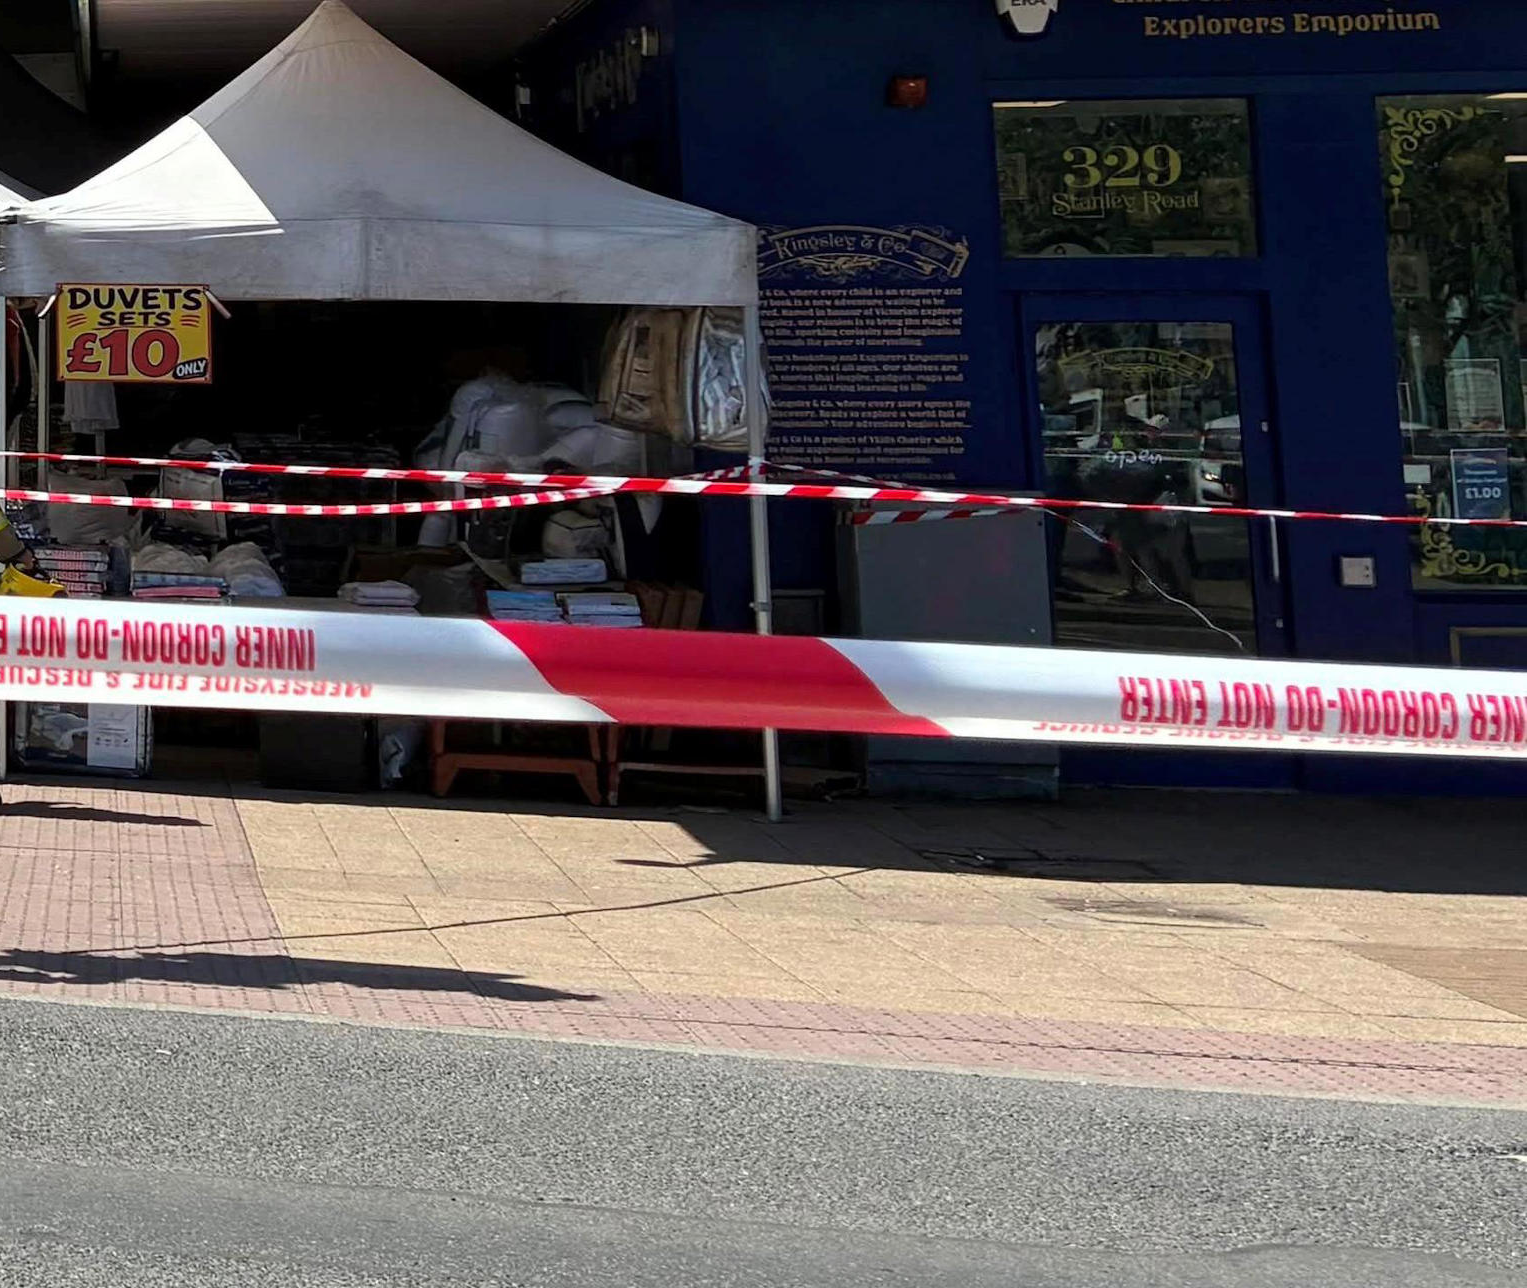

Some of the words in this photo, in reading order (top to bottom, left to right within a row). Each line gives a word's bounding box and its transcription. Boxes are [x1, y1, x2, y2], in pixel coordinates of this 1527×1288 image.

[1144, 14, 1285, 39] Explorers
[1294, 10, 1440, 36] Emporium
[1063, 144, 1182, 188] 329
[1052, 192, 1137, 216] Stanley
[1143, 190, 1199, 214] Road
[775, 233, 857, 261] Kingsley
[67, 288, 202, 311] DUVETS
[97, 311, 172, 327] SETS
[66, 329, 180, 377] £10
[175, 360, 207, 378] ONLY
[1105, 449, 1163, 469] open
[16, 614, 65, 659] NOT
[236, 624, 317, 672] INNER
[1119, 676, 1208, 725] ENTER
[1216, 681, 1275, 730] NOT
